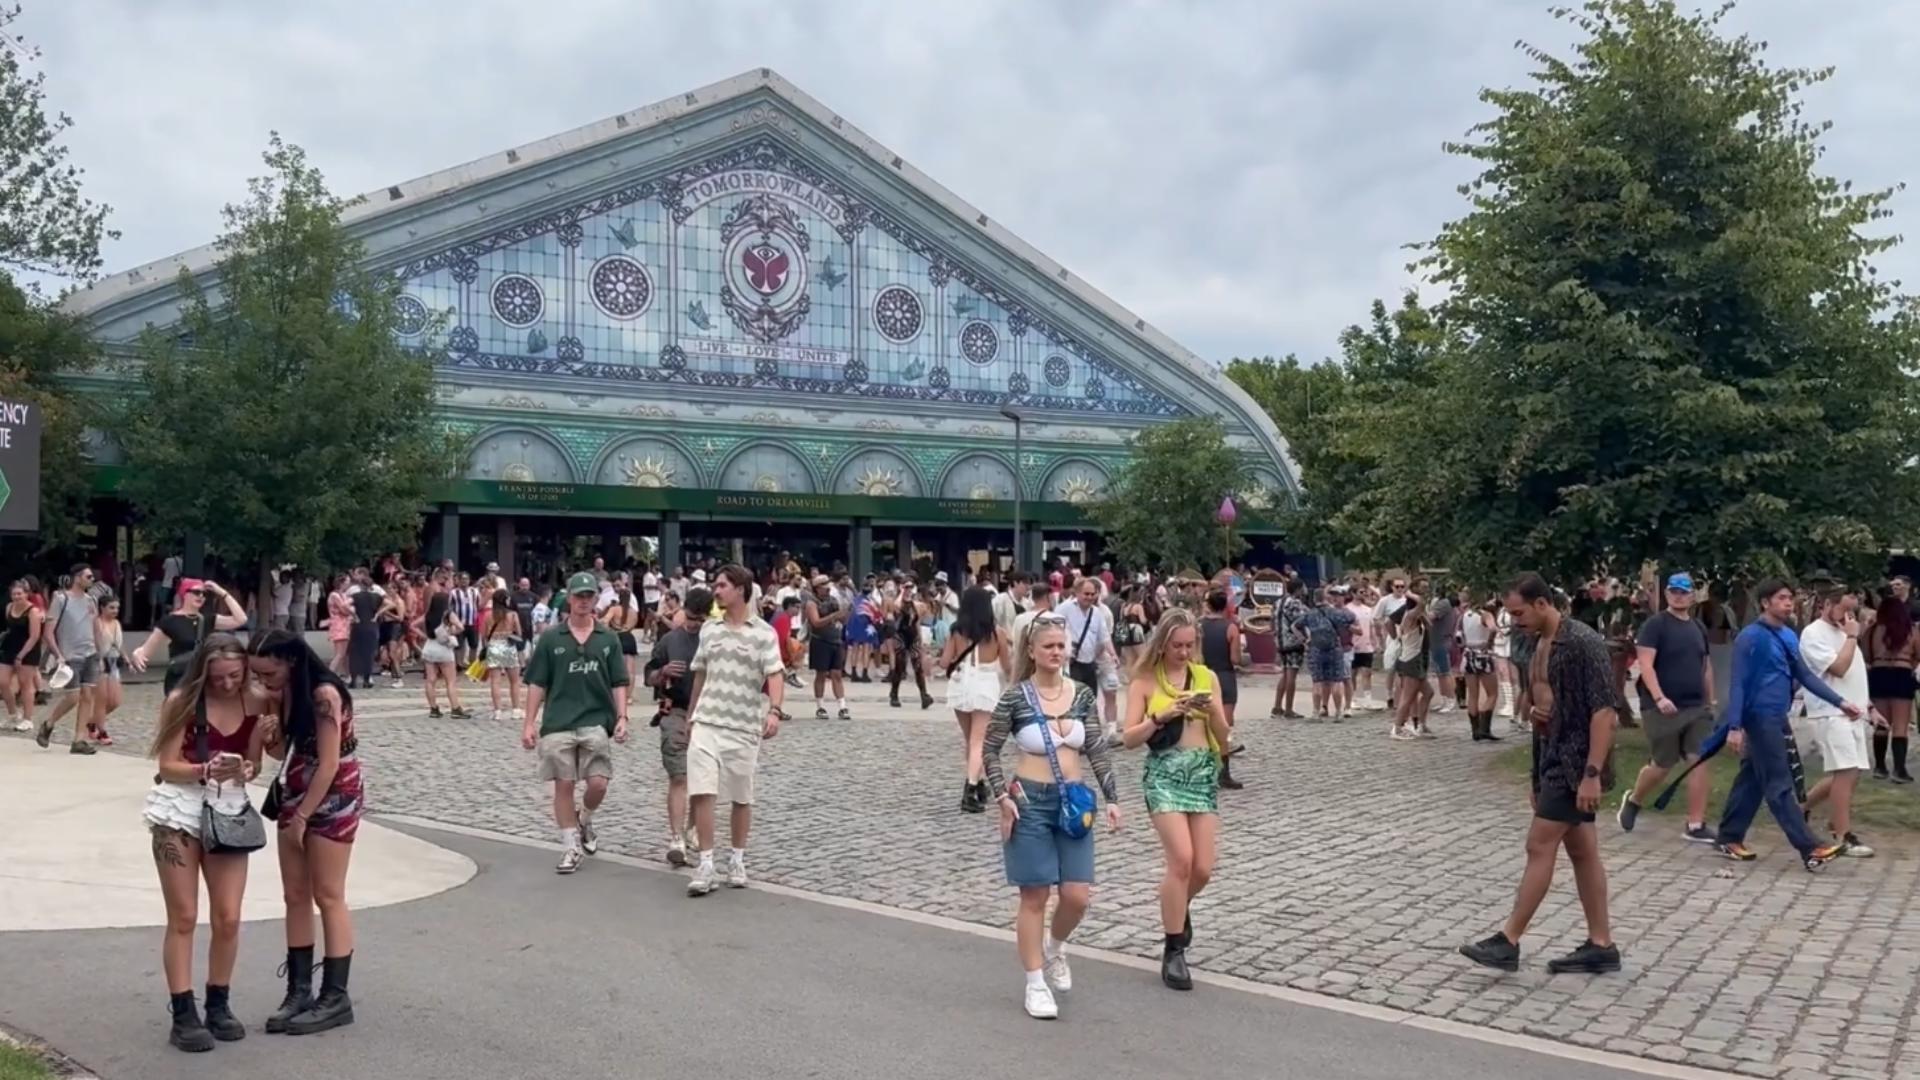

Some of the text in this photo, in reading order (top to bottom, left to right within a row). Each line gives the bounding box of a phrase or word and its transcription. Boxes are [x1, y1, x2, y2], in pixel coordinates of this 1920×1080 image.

[686, 172, 842, 221] TOMORROWLAND
[698, 341, 838, 362] LIVE LOVE UNITE
[717, 495, 831, 509] ROAD TO DREAMVILLE
